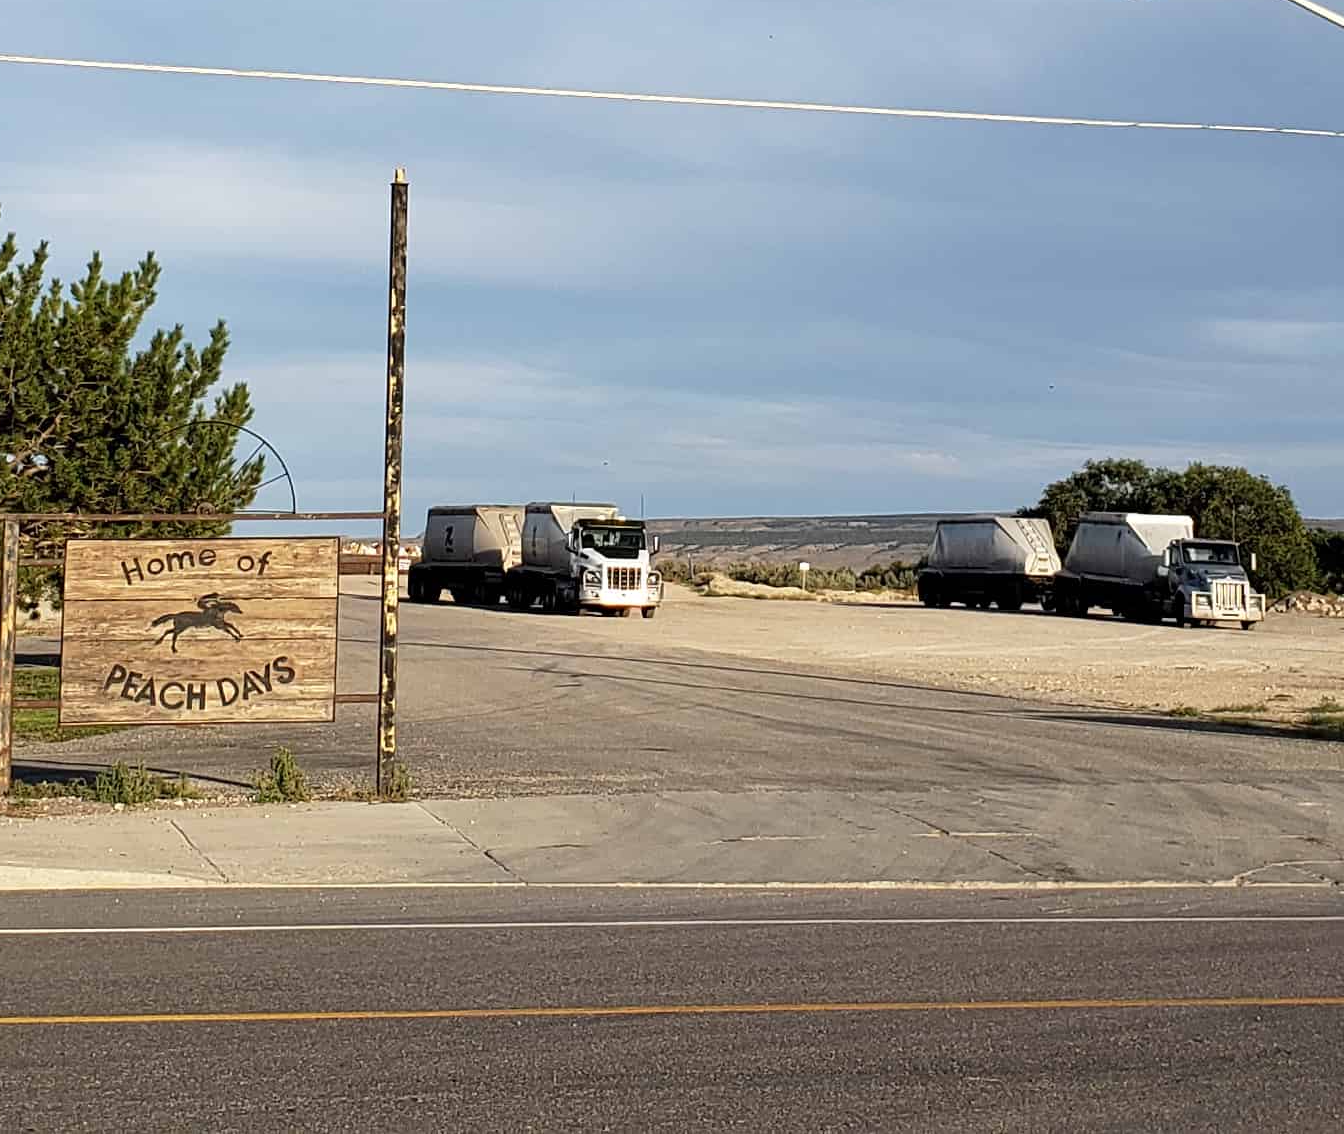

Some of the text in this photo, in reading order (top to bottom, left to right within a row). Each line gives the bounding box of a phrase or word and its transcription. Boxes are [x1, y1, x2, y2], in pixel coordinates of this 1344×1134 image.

[120, 548, 273, 585] Home of
[104, 656, 295, 710] PEACH DAYS
